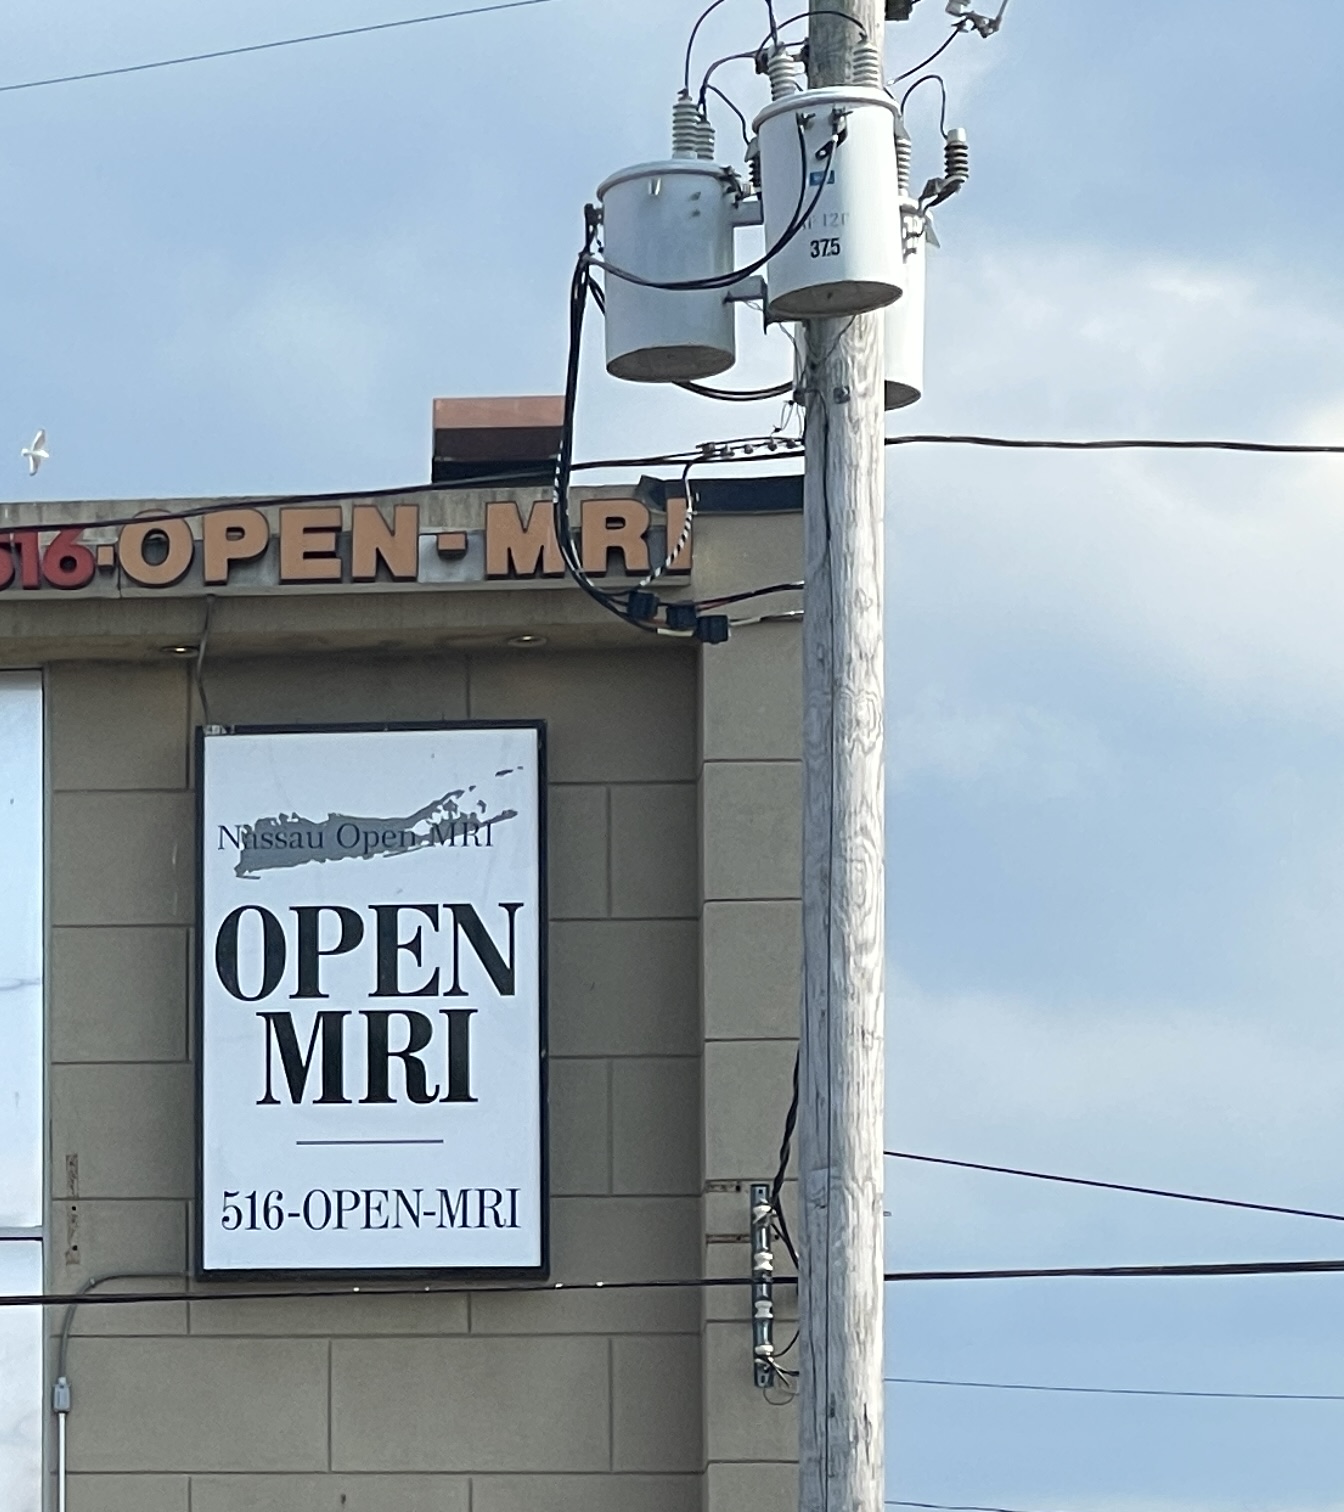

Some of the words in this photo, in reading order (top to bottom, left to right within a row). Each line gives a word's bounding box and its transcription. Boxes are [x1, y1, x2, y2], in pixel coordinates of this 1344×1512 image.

[217, 823, 324, 851] Nassau
[336, 822, 417, 856] Open
[430, 822, 494, 849] MRI
[214, 902, 523, 1001] OPEN
[255, 1008, 478, 1107] MRI
[221, 1186, 521, 1232] 516-OPEN-MRI
